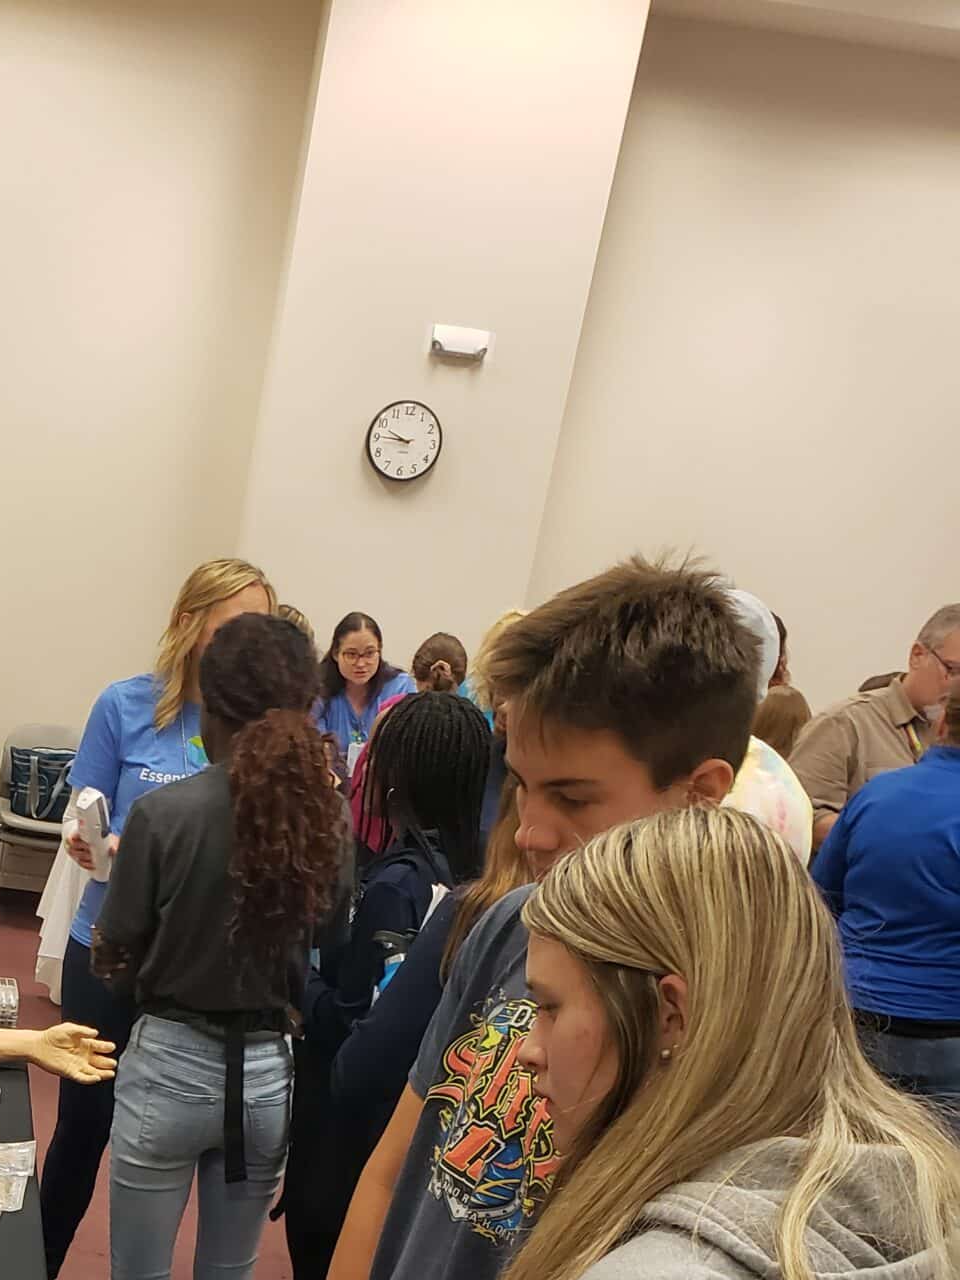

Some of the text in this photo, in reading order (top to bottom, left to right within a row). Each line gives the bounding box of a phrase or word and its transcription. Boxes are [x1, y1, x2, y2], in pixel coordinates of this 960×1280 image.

[391, 409, 400, 419] 11
[404, 406, 416, 416] 12
[420, 412, 426, 422] 1
[378, 418, 388, 428] 10
[427, 424, 434, 435] 2
[374, 432, 381, 442] 9
[429, 440, 436, 450] 3
[374, 447, 382, 458] 8
[422, 454, 430, 464] 4
[384, 460, 392, 471] 7
[410, 463, 418, 474] 5
[396, 466, 403, 476] 6
[139, 768, 192, 784] Essen
